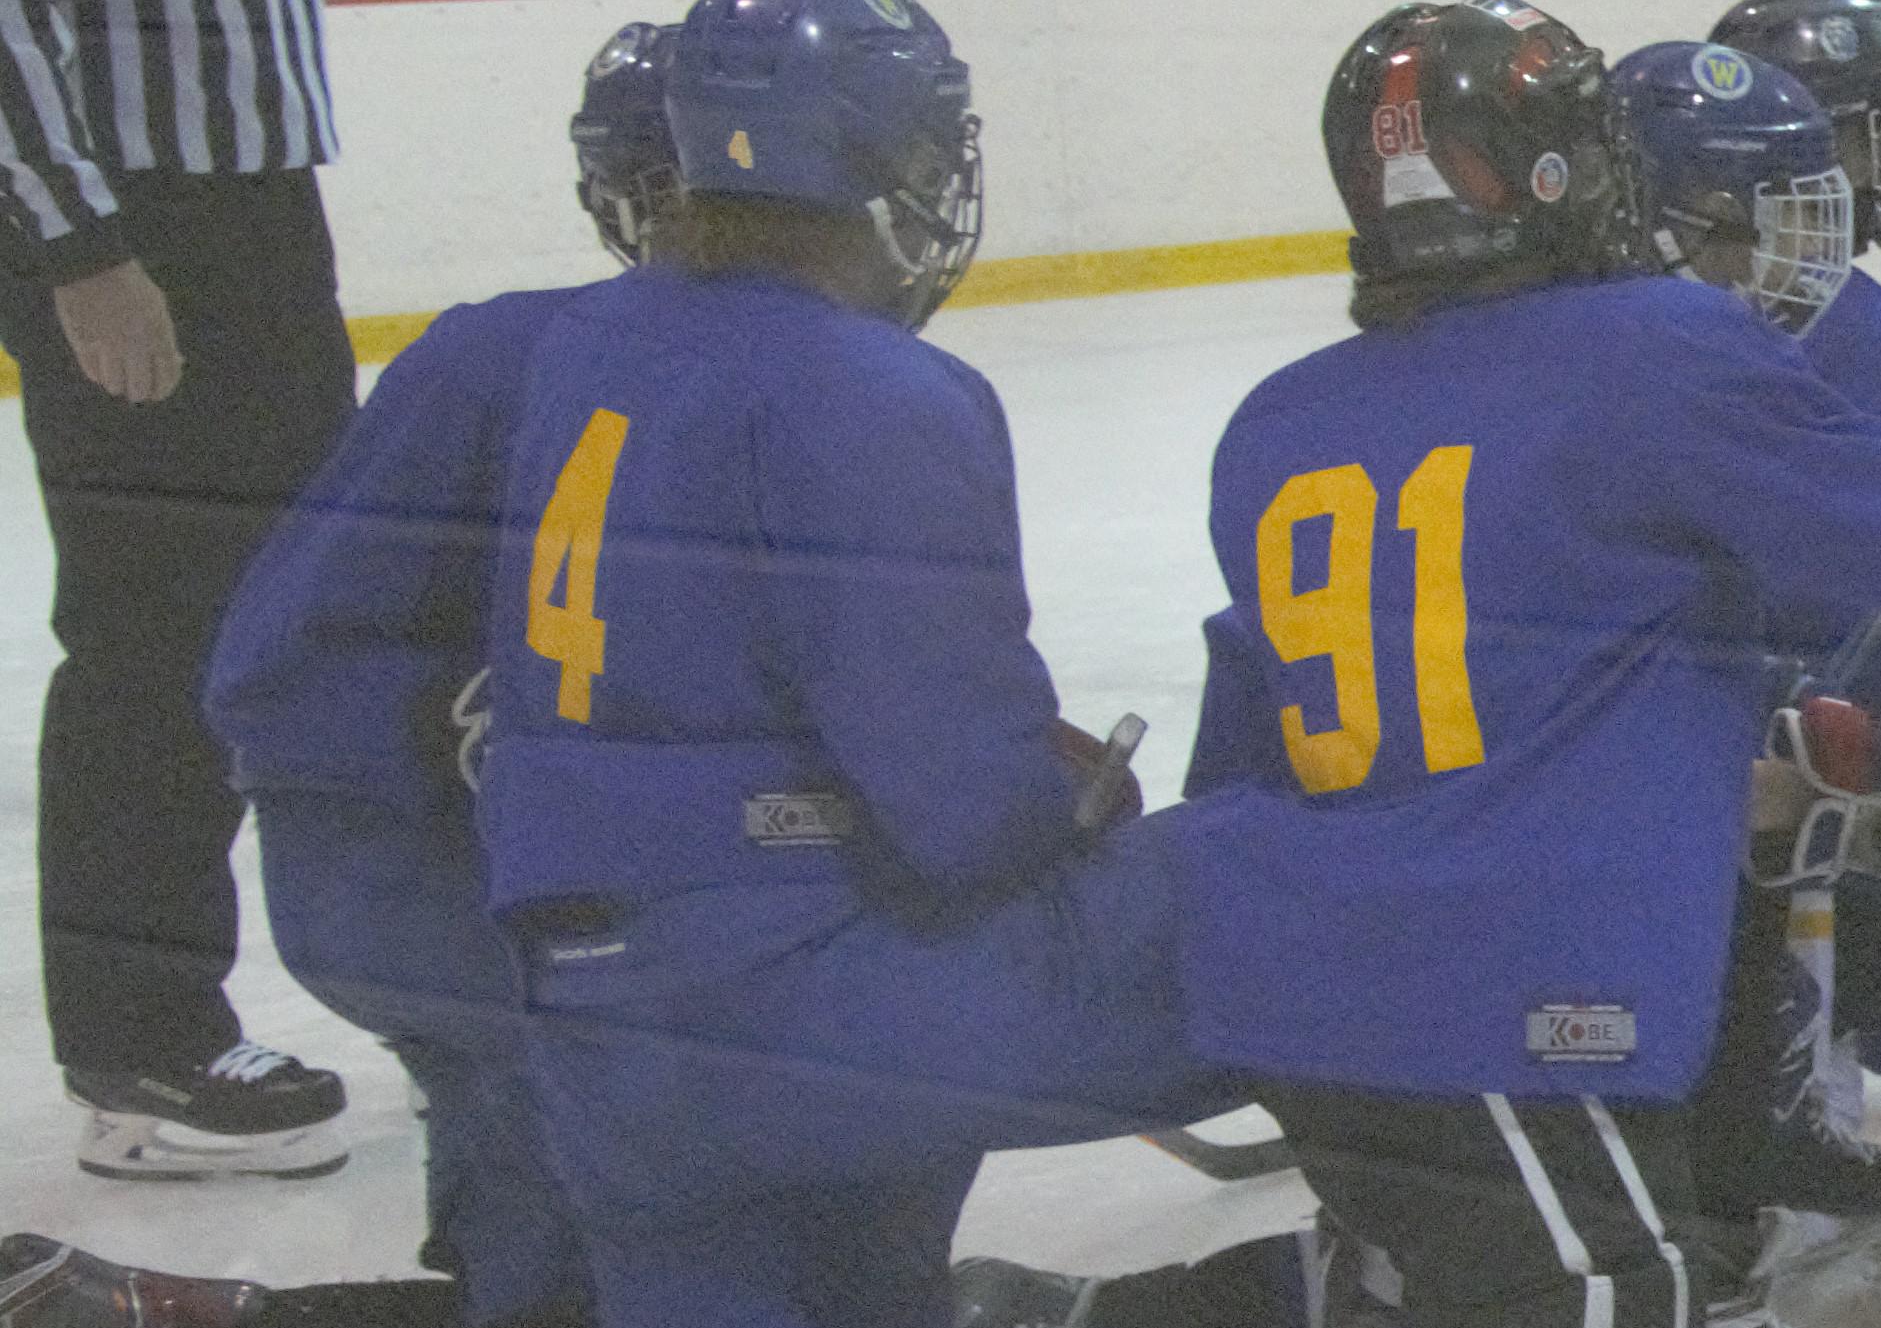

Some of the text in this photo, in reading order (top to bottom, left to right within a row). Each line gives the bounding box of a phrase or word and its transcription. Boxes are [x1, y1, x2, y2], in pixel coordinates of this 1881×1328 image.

[1372, 100, 1429, 159] 81
[526, 408, 629, 724] 4
[1255, 443, 1486, 794] 91
[1551, 1017, 1616, 1047] KOBE
